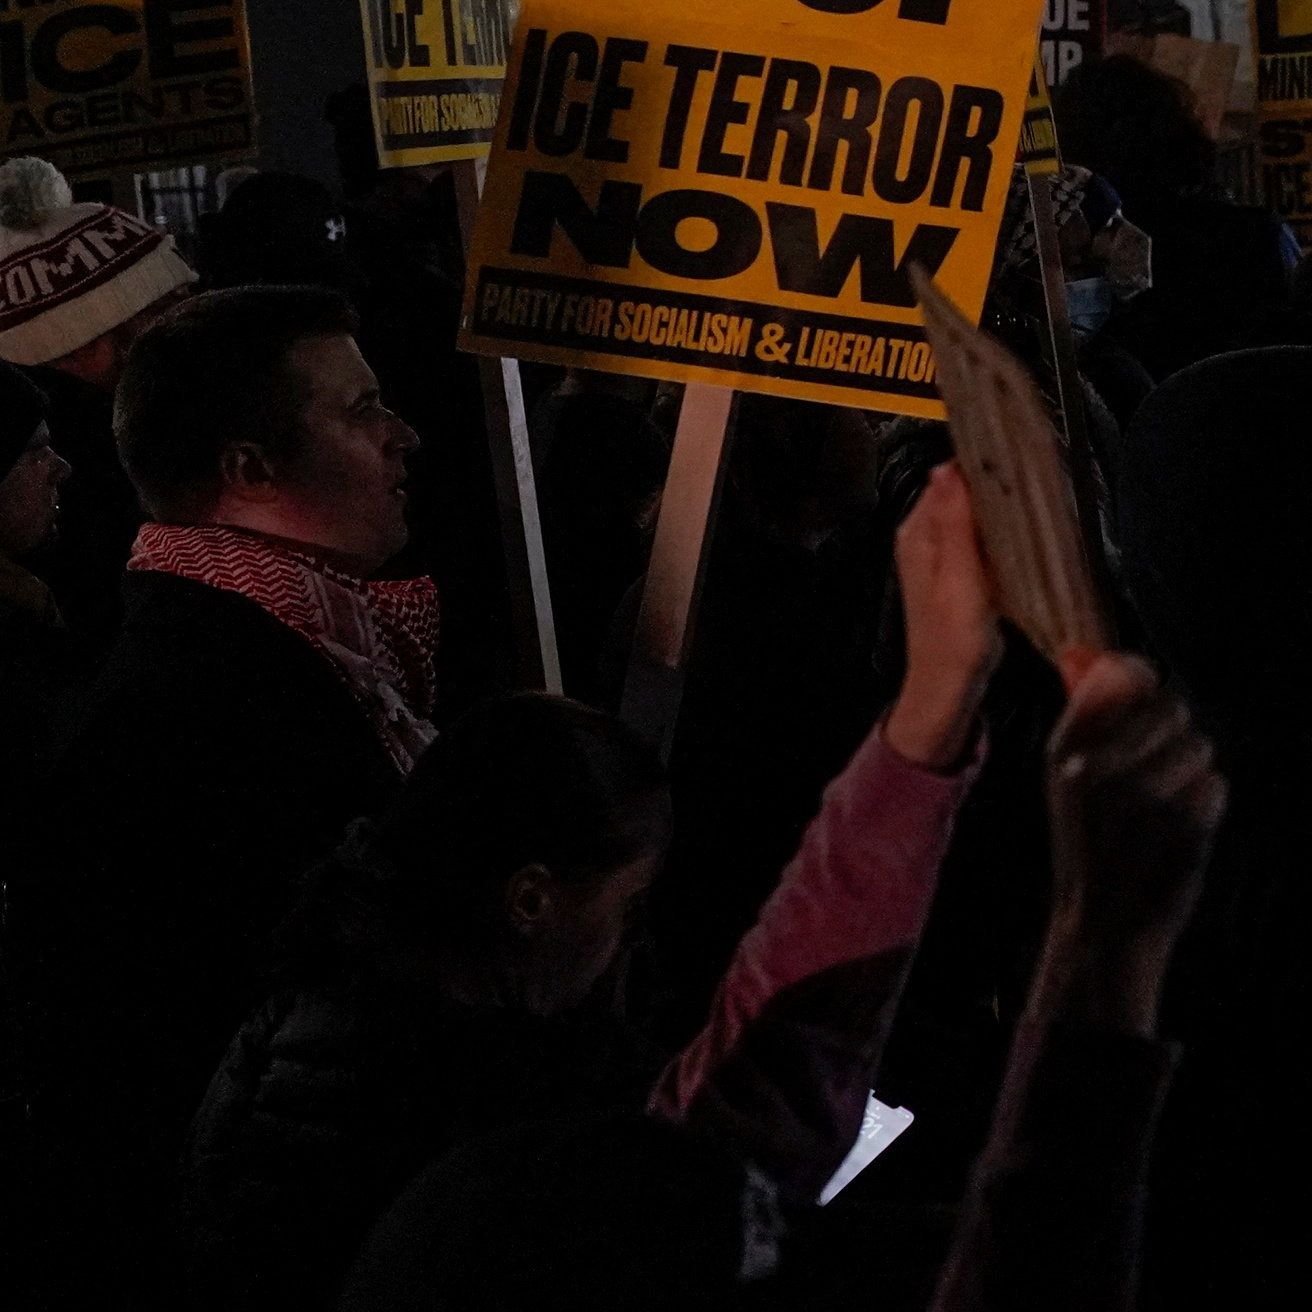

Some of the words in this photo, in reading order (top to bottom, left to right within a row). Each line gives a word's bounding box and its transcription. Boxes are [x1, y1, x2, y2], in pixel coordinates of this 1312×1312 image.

[7, 75, 245, 145] AGENTS
[506, 29, 648, 163] ICE
[659, 44, 1004, 212] TERROR
[0, 214, 148, 306] OMM
[510, 171, 960, 308] NOW
[480, 282, 563, 333] PARTY
[561, 294, 612, 341] FOR
[612, 300, 754, 358] SOCIALISM
[754, 321, 794, 365] &
